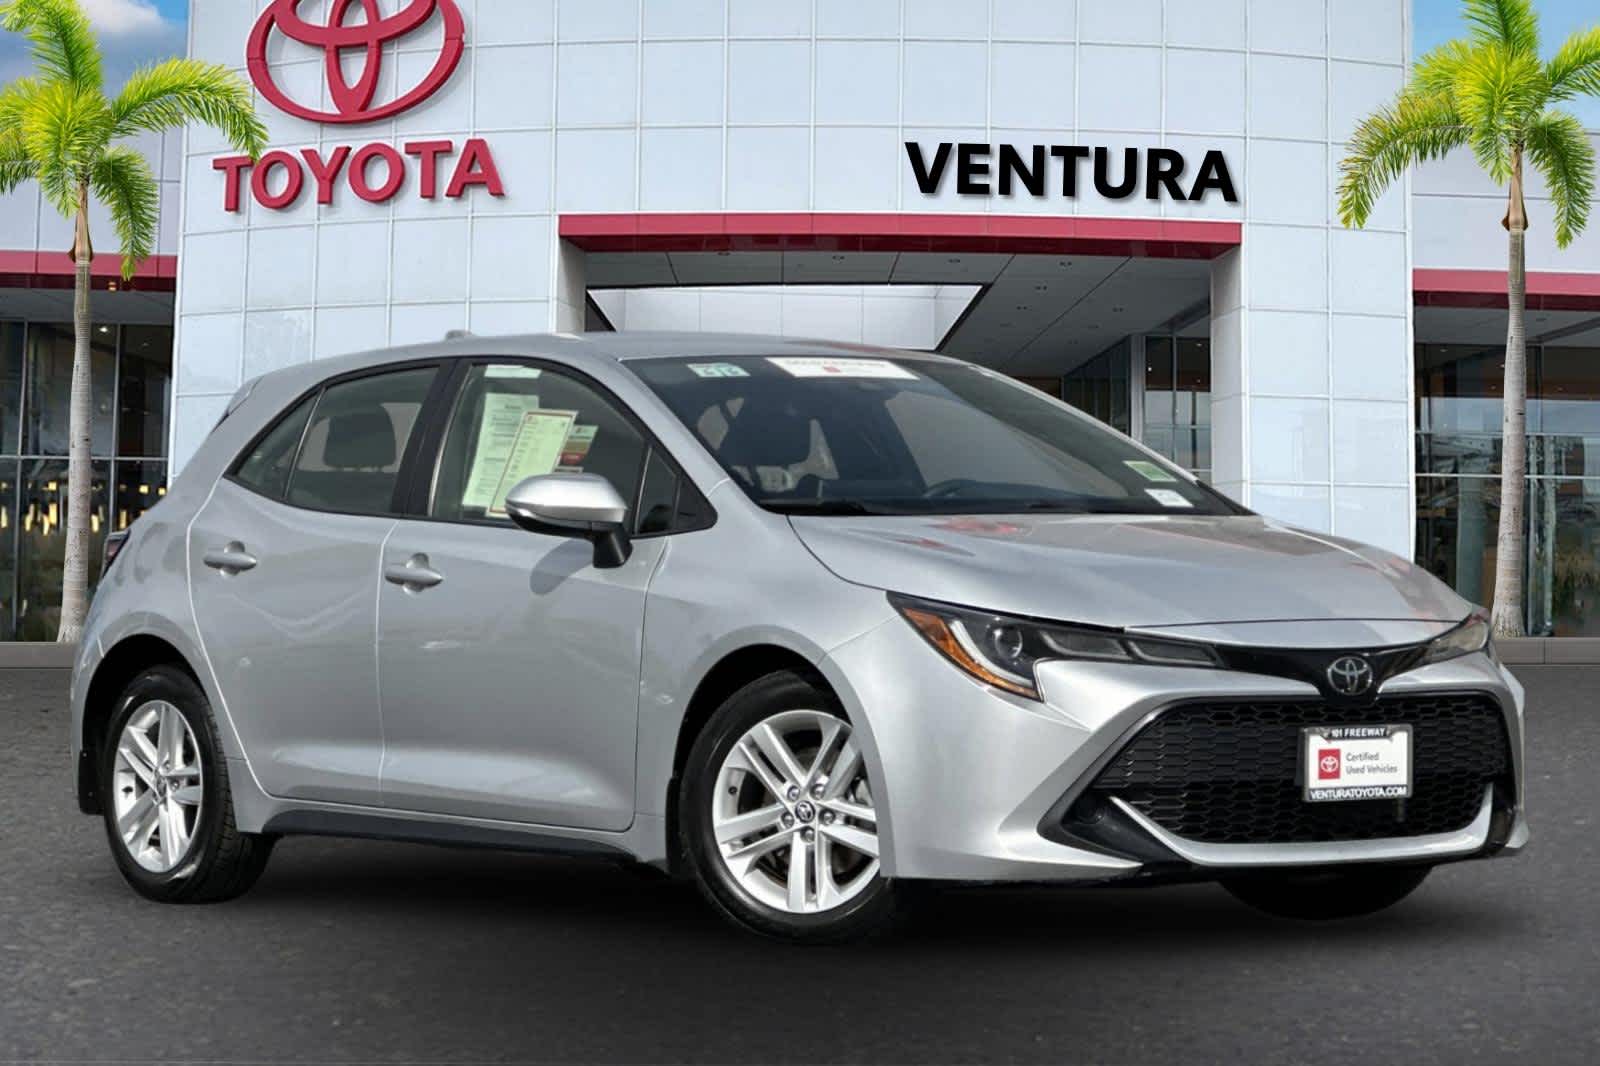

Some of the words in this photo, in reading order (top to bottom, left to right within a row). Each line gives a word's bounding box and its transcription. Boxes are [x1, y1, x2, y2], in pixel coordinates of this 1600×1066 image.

[213, 138, 505, 212] TOYOTA
[905, 142, 1239, 203] VENTURA
[1331, 728, 1343, 738] 101
[1344, 727, 1386, 737] FREEWAY
[1345, 751, 1380, 762] Certified
[1345, 765, 1366, 775] Used
[1367, 763, 1398, 774] Vehicles
[1310, 786, 1407, 800] VENTURATOYOTA.COM
